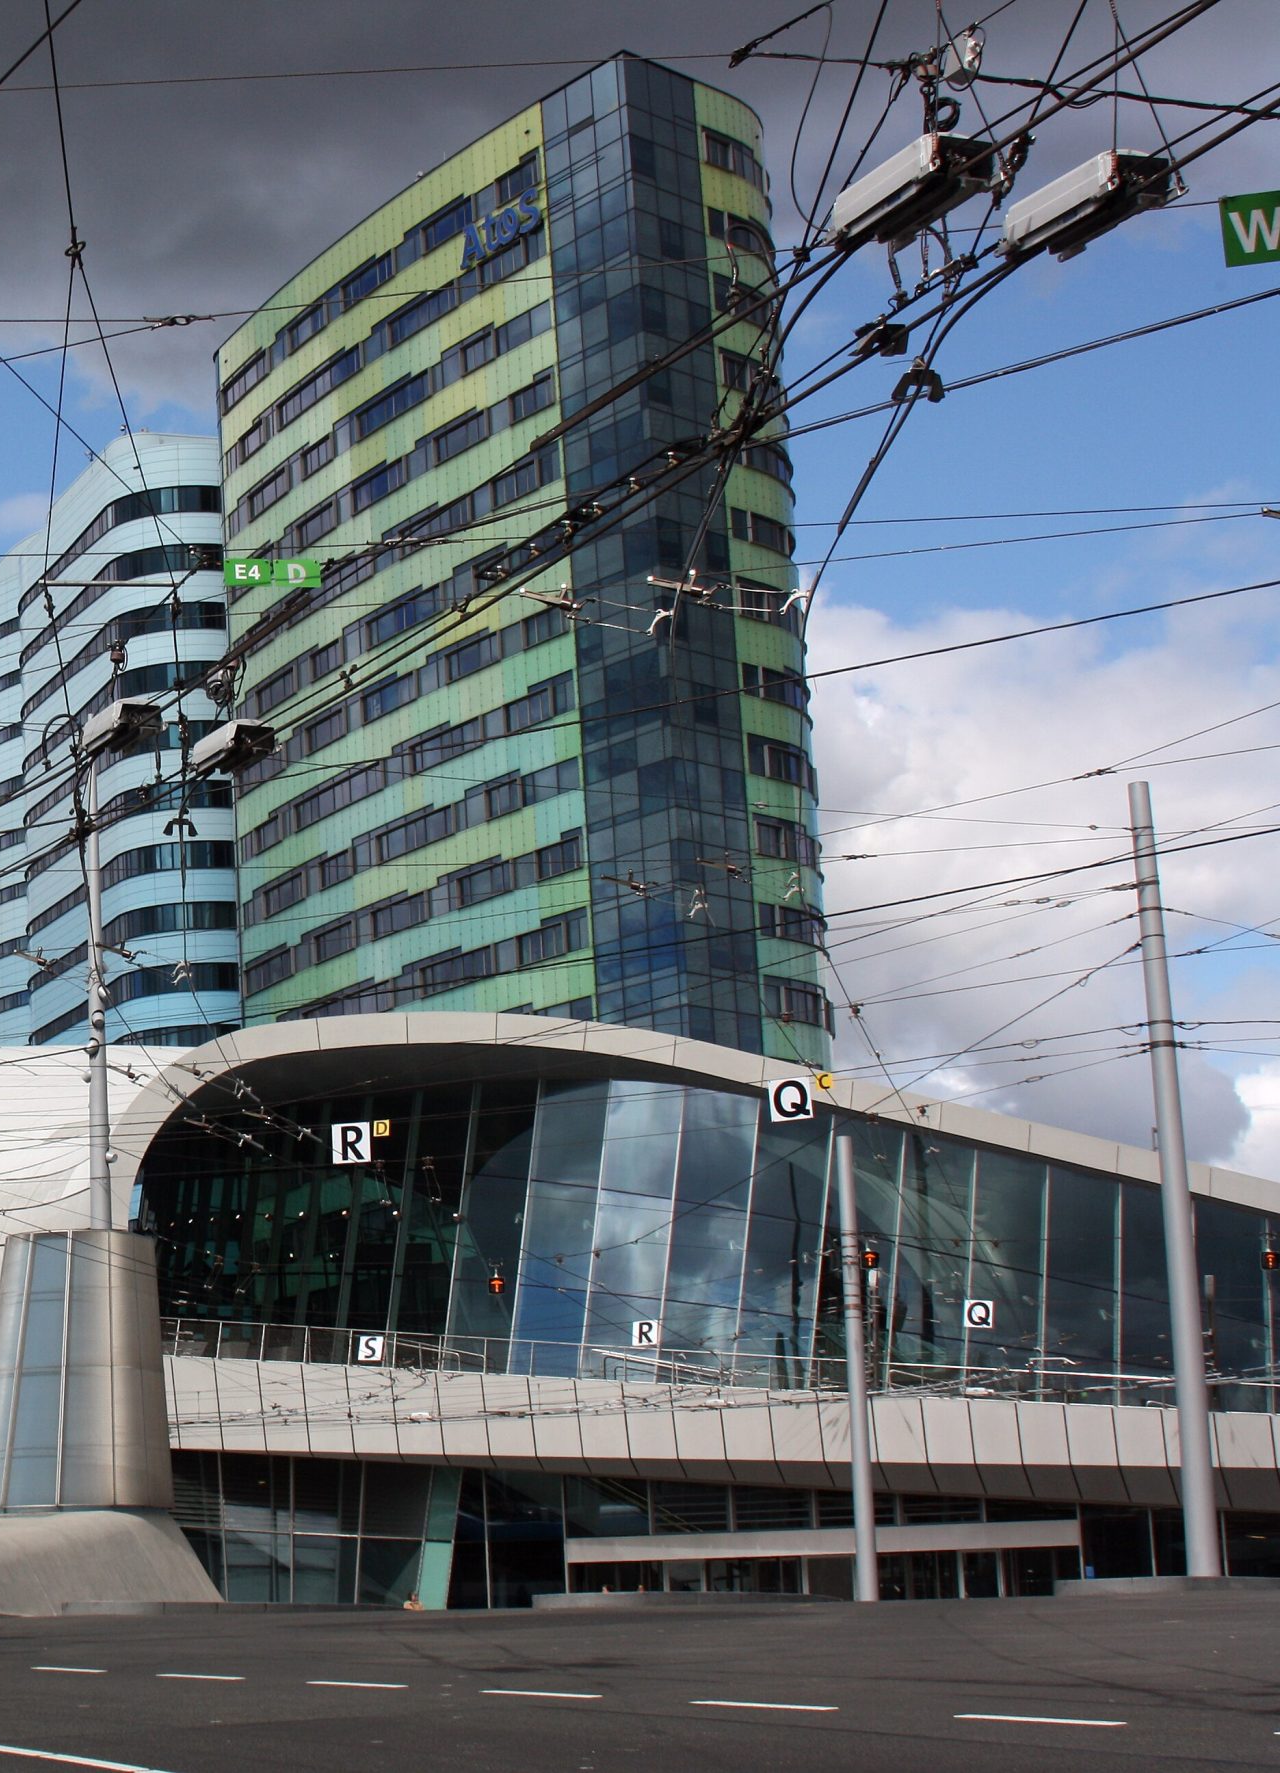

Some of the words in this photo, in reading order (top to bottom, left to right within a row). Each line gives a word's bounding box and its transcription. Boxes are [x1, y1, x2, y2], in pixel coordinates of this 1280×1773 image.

[234, 564, 260, 580] E4
[287, 563, 306, 583] D
[819, 1074, 830, 1089] C
[773, 1080, 811, 1118] Q
[376, 1122, 387, 1135] D
[341, 1126, 365, 1160] R
[967, 1301, 990, 1326] Q
[639, 1322, 653, 1343] R
[364, 1337, 376, 1358] S
